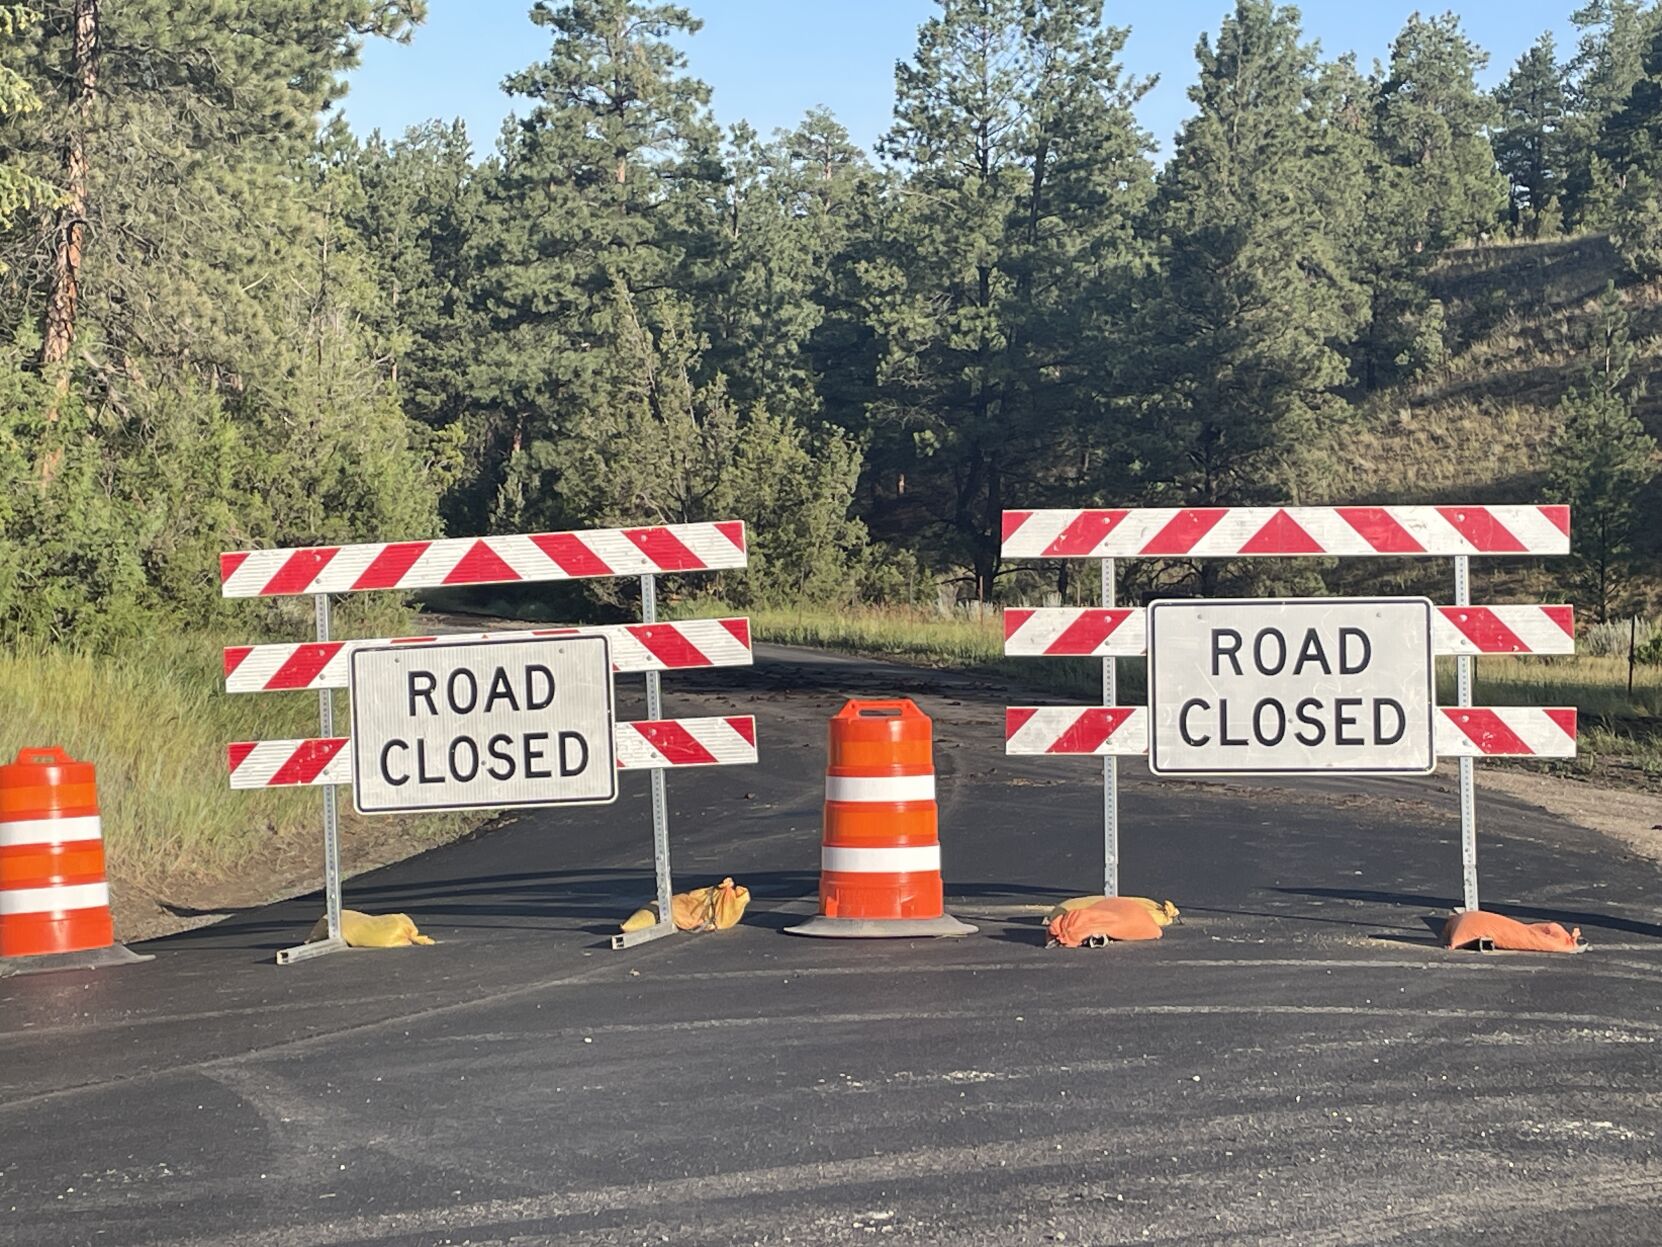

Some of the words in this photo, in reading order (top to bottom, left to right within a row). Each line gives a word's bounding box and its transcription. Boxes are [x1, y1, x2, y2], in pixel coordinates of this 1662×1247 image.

[1211, 627, 1372, 676] ROAD
[408, 664, 556, 717] ROAD
[1179, 697, 1406, 747] CLOSED
[380, 730, 589, 787] CLOSED
